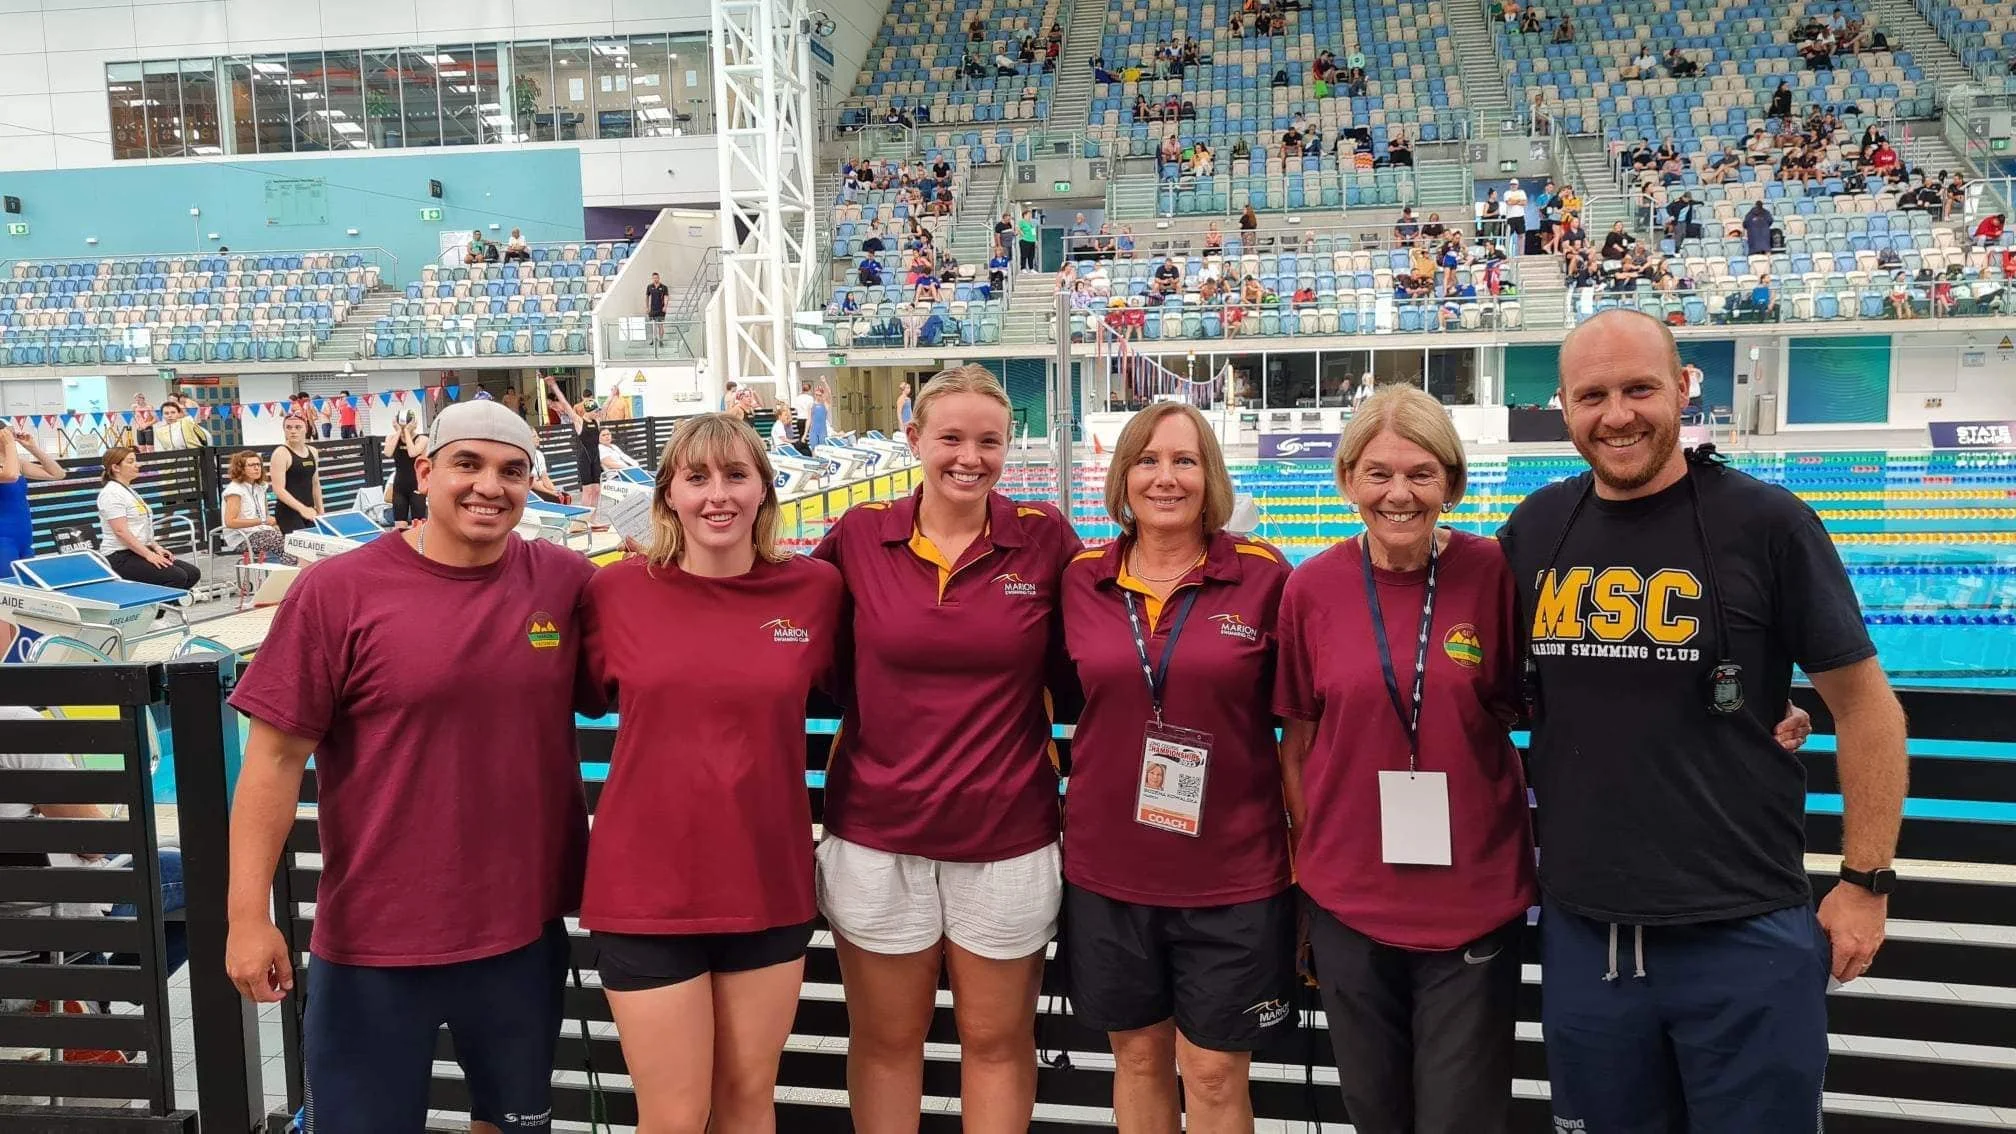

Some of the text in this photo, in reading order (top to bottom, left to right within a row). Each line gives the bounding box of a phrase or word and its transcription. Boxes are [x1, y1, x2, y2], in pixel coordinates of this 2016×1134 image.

[1475, 150, 1482, 160] 5
[1024, 171, 1030, 181] 6
[1956, 425, 2010, 437] STATE
[1958, 436, 2013, 445] CHAMPS
[829, 463, 837, 473] 6
[777, 474, 786, 486] 5
[287, 538, 326, 552] ADELAIDE
[1004, 582, 1036, 592] MARION
[1532, 566, 1702, 645] MSC
[109, 613, 141, 626] ADELAIDE
[774, 628, 808, 638] MARION
[1221, 623, 1258, 637] MARION
[1571, 642, 1649, 659] SWIMMING
[1656, 647, 1700, 662] CLUB
[1148, 813, 1188, 830] COACH
[1553, 1115, 1585, 1129] arena
